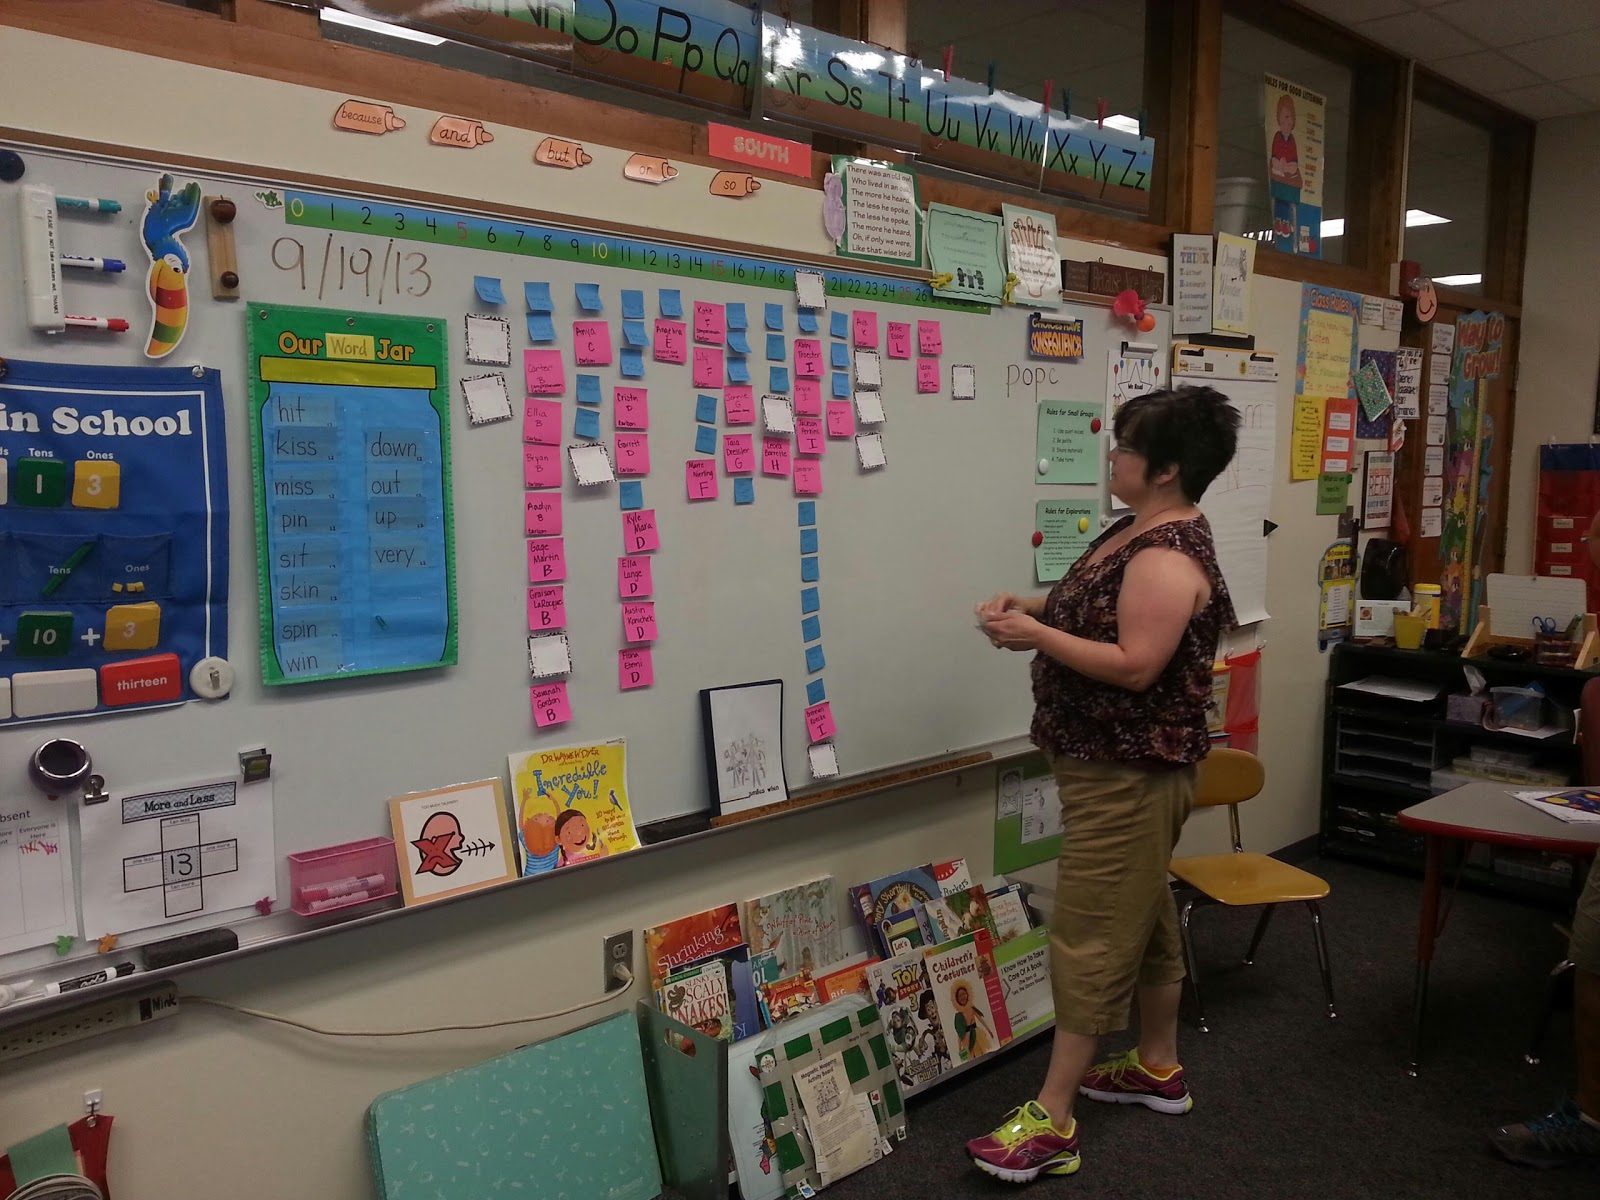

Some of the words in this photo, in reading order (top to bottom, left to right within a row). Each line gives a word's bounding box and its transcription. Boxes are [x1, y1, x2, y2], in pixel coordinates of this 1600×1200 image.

[652, 6, 703, 94] Pp
[714, 28, 750, 110] Qq
[825, 57, 862, 110] Ss
[878, 70, 910, 122] Tt
[926, 89, 960, 142] Uu
[974, 103, 998, 150] Vv
[1009, 114, 1045, 163] Ww
[1049, 129, 1078, 175] Xx
[1089, 140, 1111, 199] Yy
[1119, 149, 1145, 190] Zz
[341, 105, 382, 125] because
[439, 124, 471, 143] and
[546, 141, 570, 163] but
[733, 136, 789, 165] SOUTH
[639, 164, 652, 176] or
[724, 180, 736, 190] so
[851, 188, 864, 196] The
[883, 193, 891, 201] he
[853, 200, 865, 208] The
[866, 202, 880, 210] less
[291, 198, 304, 217] 0
[330, 203, 335, 221] 1
[361, 207, 372, 225] 2
[394, 213, 405, 230] 3
[425, 217, 437, 235] 4
[457, 222, 468, 240] 5
[487, 226, 497, 243] 6
[515, 230, 525, 247] 7
[543, 234, 553, 251] 8
[570, 238, 580, 255] 9
[591, 241, 608, 259] 10
[621, 246, 631, 263] 11
[643, 249, 657, 266] 12
[666, 252, 680, 269] 13
[689, 257, 702, 273] 14
[711, 260, 725, 276] 15
[733, 262, 745, 278] 16
[753, 266, 766, 280] 17
[774, 268, 786, 284] 18
[831, 277, 842, 291] 21
[848, 278, 860, 293] 22
[865, 281, 878, 296] 23
[882, 283, 895, 298] 24
[899, 286, 912, 301] 25
[915, 288, 928, 302] 26
[852, 244, 866, 252] Like
[866, 247, 882, 255] that
[271, 233, 432, 304] 9/19/13
[1310, 288, 1329, 309] Class
[1330, 292, 1349, 313] Rules
[278, 331, 323, 356] Our
[330, 336, 368, 357] Word
[376, 338, 415, 361] Jar
[896, 342, 904, 353] L
[0, 403, 40, 433] in
[52, 406, 192, 436] School
[278, 396, 306, 423] hit
[28, 447, 54, 458] Tens
[276, 429, 317, 456] kiss
[371, 432, 417, 457] down
[86, 450, 114, 460] Ones
[735, 458, 742, 469] G
[771, 459, 780, 471] H
[36, 474, 42, 494] 1
[86, 474, 102, 496] 3
[274, 476, 314, 497] miss
[371, 470, 401, 495] out
[699, 481, 708, 496] F
[282, 509, 308, 533] pin
[375, 511, 397, 530] up
[626, 512, 642, 525] Kyle
[634, 522, 653, 534] Mara
[530, 541, 549, 555] Gage
[636, 536, 646, 549] D
[280, 542, 309, 569] sit
[375, 548, 415, 568] very
[534, 553, 560, 564] Martin
[622, 559, 637, 568] Ella
[48, 565, 71, 574] Tens
[125, 564, 150, 573] Ones
[624, 571, 642, 582] Lange
[280, 574, 319, 601] skin
[624, 605, 646, 615] Austin
[33, 628, 57, 645] 10
[123, 622, 136, 638] 3
[281, 620, 317, 642] spin
[285, 651, 318, 673] win
[117, 675, 167, 691] thirteen
[533, 760, 607, 796] Incredible
[144, 799, 171, 813] More
[173, 799, 189, 808] and
[189, 793, 215, 805] Less
[19, 824, 49, 834] Everyone
[171, 853, 193, 875] 13
[657, 926, 724, 974] Shrinking
[893, 941, 908, 951] Let's
[932, 950, 974, 974] Children's
[1003, 963, 1017, 974] Know
[1016, 957, 1026, 967] How
[1033, 950, 1045, 959] Take
[892, 963, 918, 986] TOY
[936, 963, 976, 984] Costumes
[686, 977, 725, 1004] SCALY
[899, 981, 920, 995] STORY
[153, 994, 177, 1012] Mink
[908, 993, 919, 1012] 3
